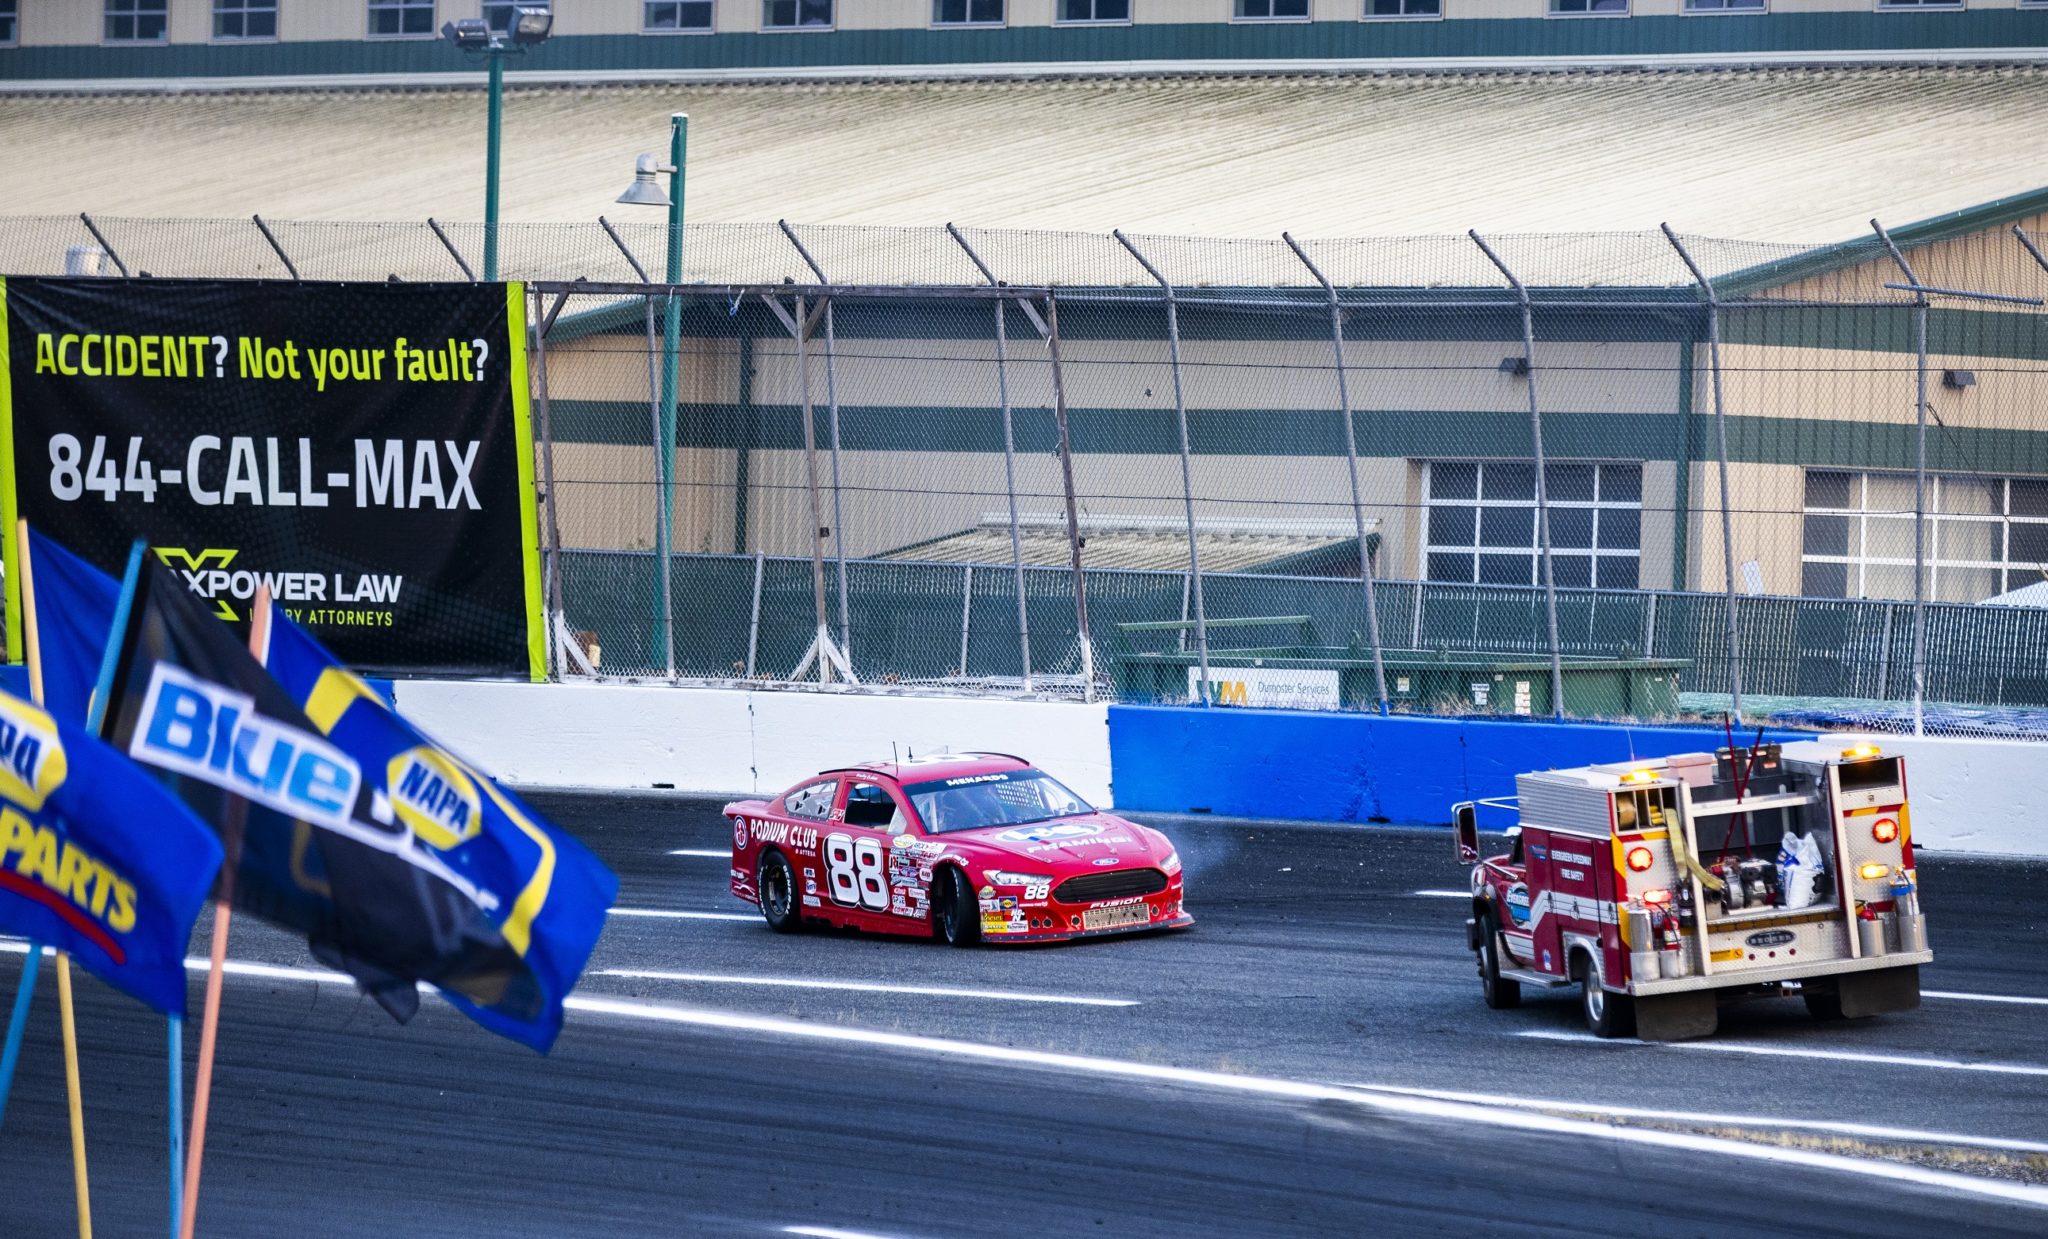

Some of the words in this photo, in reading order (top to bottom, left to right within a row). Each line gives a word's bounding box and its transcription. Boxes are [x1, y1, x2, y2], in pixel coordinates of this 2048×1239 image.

[36, 333, 229, 378] ACCIDENT?
[240, 338, 301, 379] Not
[309, 346, 385, 392] your
[395, 338, 489, 382] fault?
[49, 432, 482, 511] 844-CALL-MAX
[170, 568, 327, 601] XPOWER
[335, 573, 403, 603] LAW
[308, 609, 394, 627] ATTORNEYS
[1257, 681, 1294, 694] Dumpster
[1297, 682, 1329, 695] Services
[145, 680, 352, 817] Blue
[400, 761, 468, 833] NAPA
[946, 774, 1008, 788] MENARDS
[750, 819, 789, 844] PODIUM
[790, 825, 817, 849] CLUB
[0, 806, 137, 932] PARTS
[822, 833, 889, 912] 88
[1024, 885, 1050, 900] 88
[1090, 897, 1143, 909] FUSION
